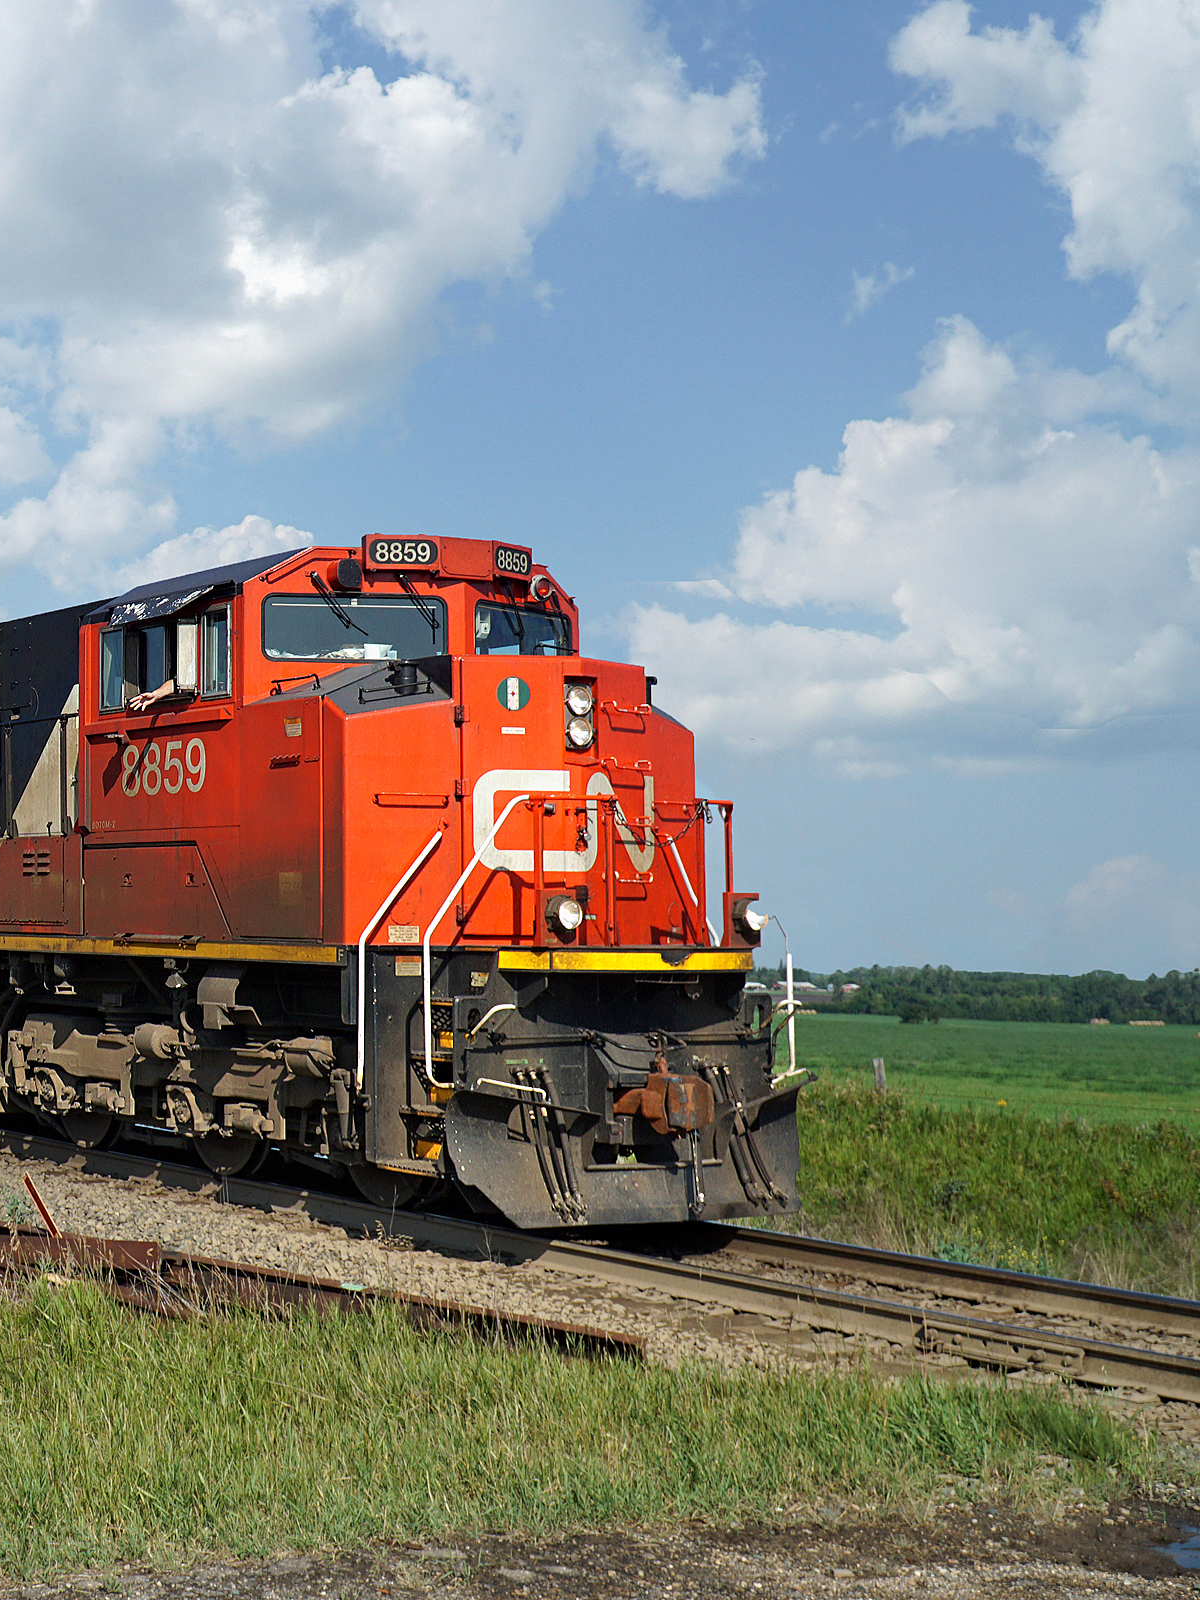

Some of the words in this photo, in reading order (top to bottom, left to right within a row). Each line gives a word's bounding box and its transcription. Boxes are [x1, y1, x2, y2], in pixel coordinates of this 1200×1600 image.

[375, 542, 431, 562] 8859
[497, 549, 528, 573] 8859
[121, 737, 206, 797] 8859
[473, 769, 655, 872] CN
[338, 948, 344, 961] F
